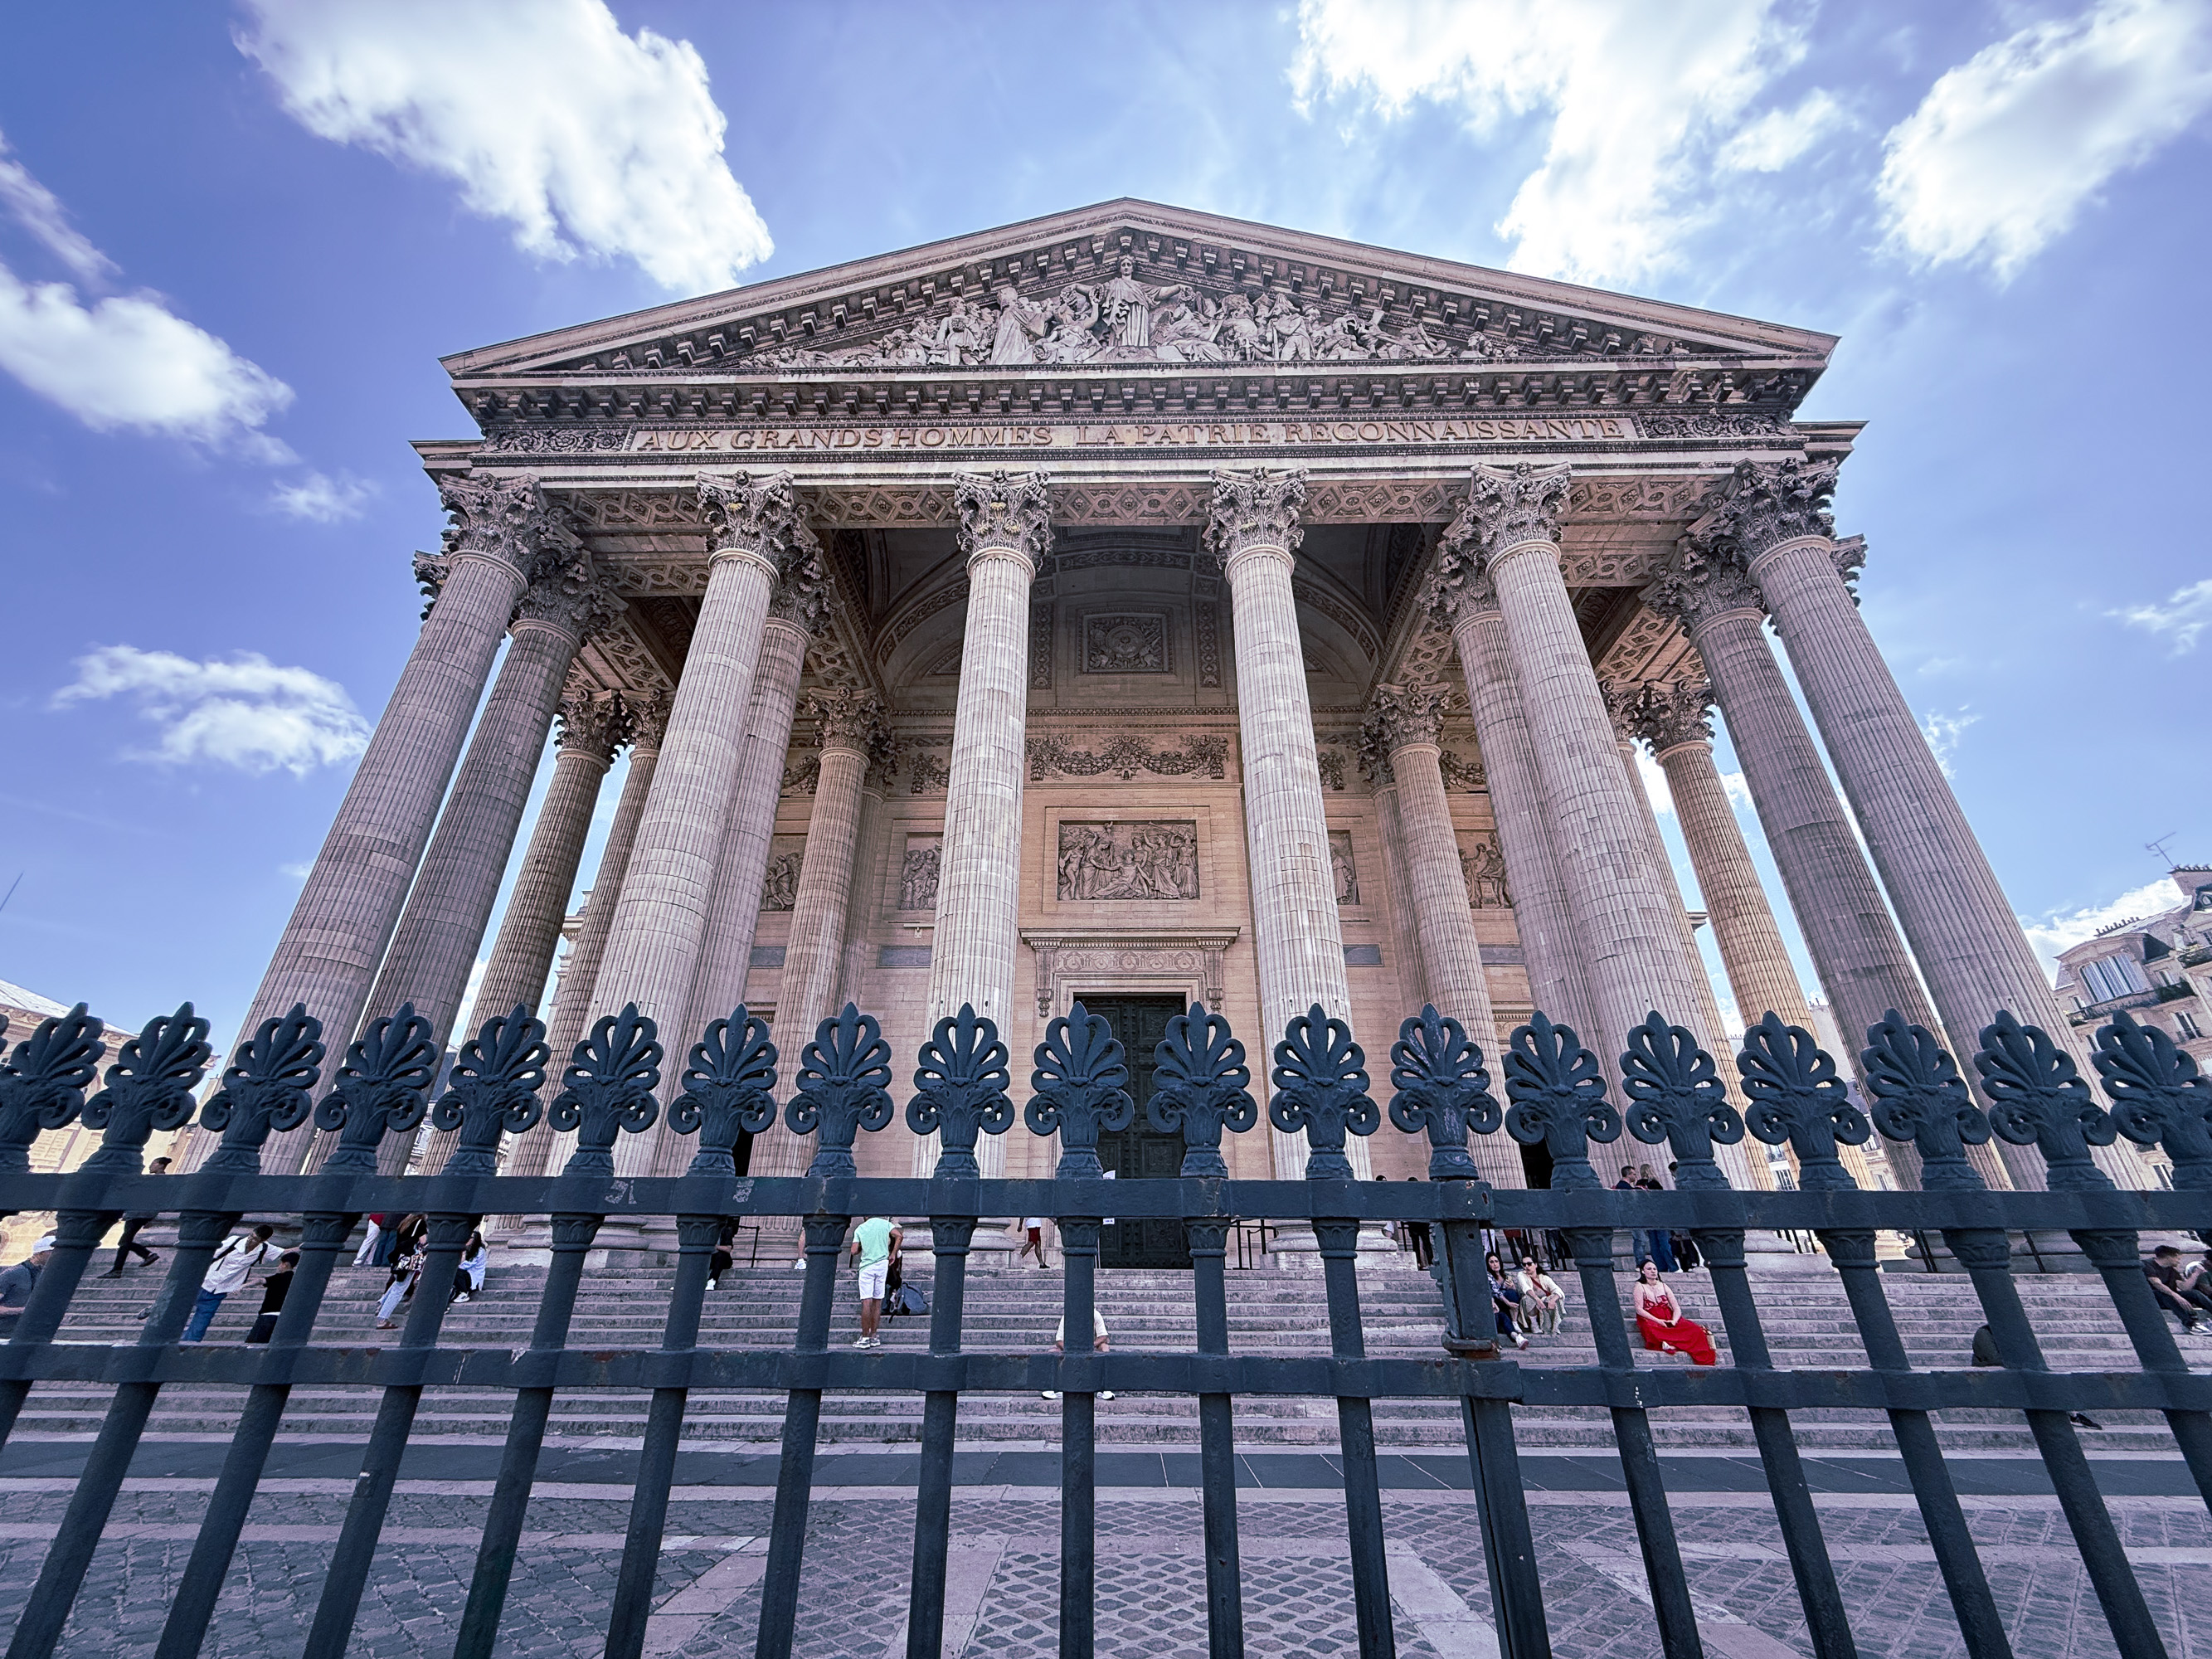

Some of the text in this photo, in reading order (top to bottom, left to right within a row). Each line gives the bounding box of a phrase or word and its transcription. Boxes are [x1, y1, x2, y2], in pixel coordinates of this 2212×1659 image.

[637, 419, 1625, 450] AUX GRANDS HOMMES LA PATRIE RECONNAISSANTE
